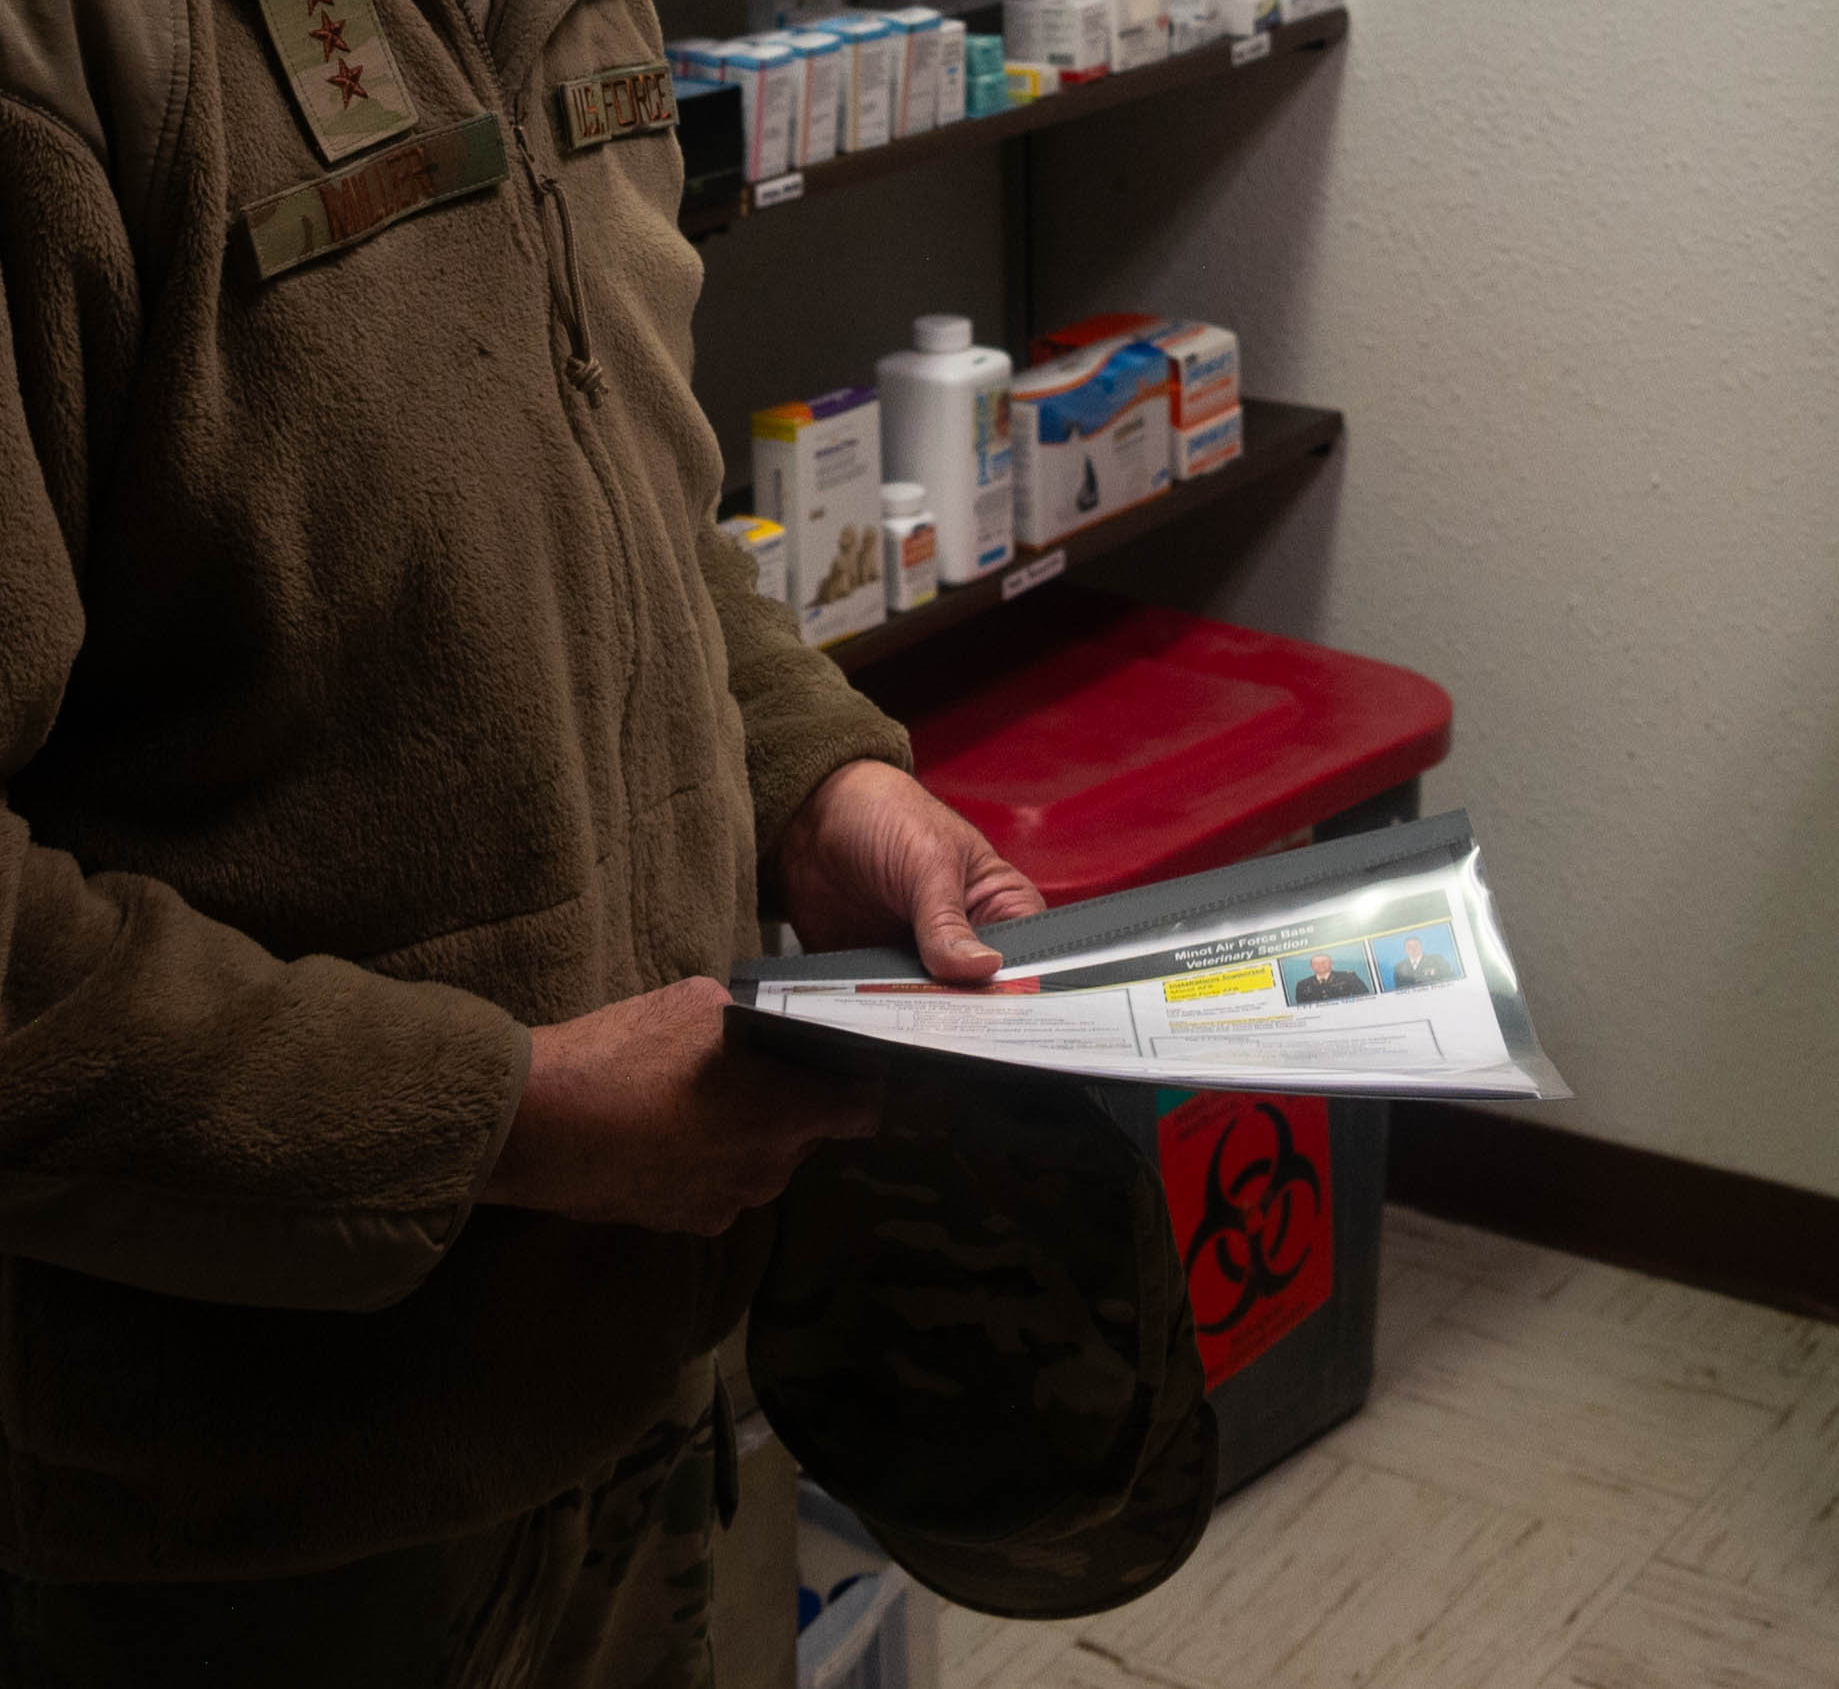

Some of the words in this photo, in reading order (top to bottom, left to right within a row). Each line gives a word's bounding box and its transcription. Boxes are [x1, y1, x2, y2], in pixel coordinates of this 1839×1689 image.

[601, 72, 672, 128] FORCE
[1174, 946, 1213, 962] Minot
[1216, 940, 1235, 955] Air
[1238, 933, 1277, 949] Force
[1281, 924, 1315, 940] Base
[1187, 949, 1254, 970] Veterinary
[1258, 939, 1309, 956] Section
